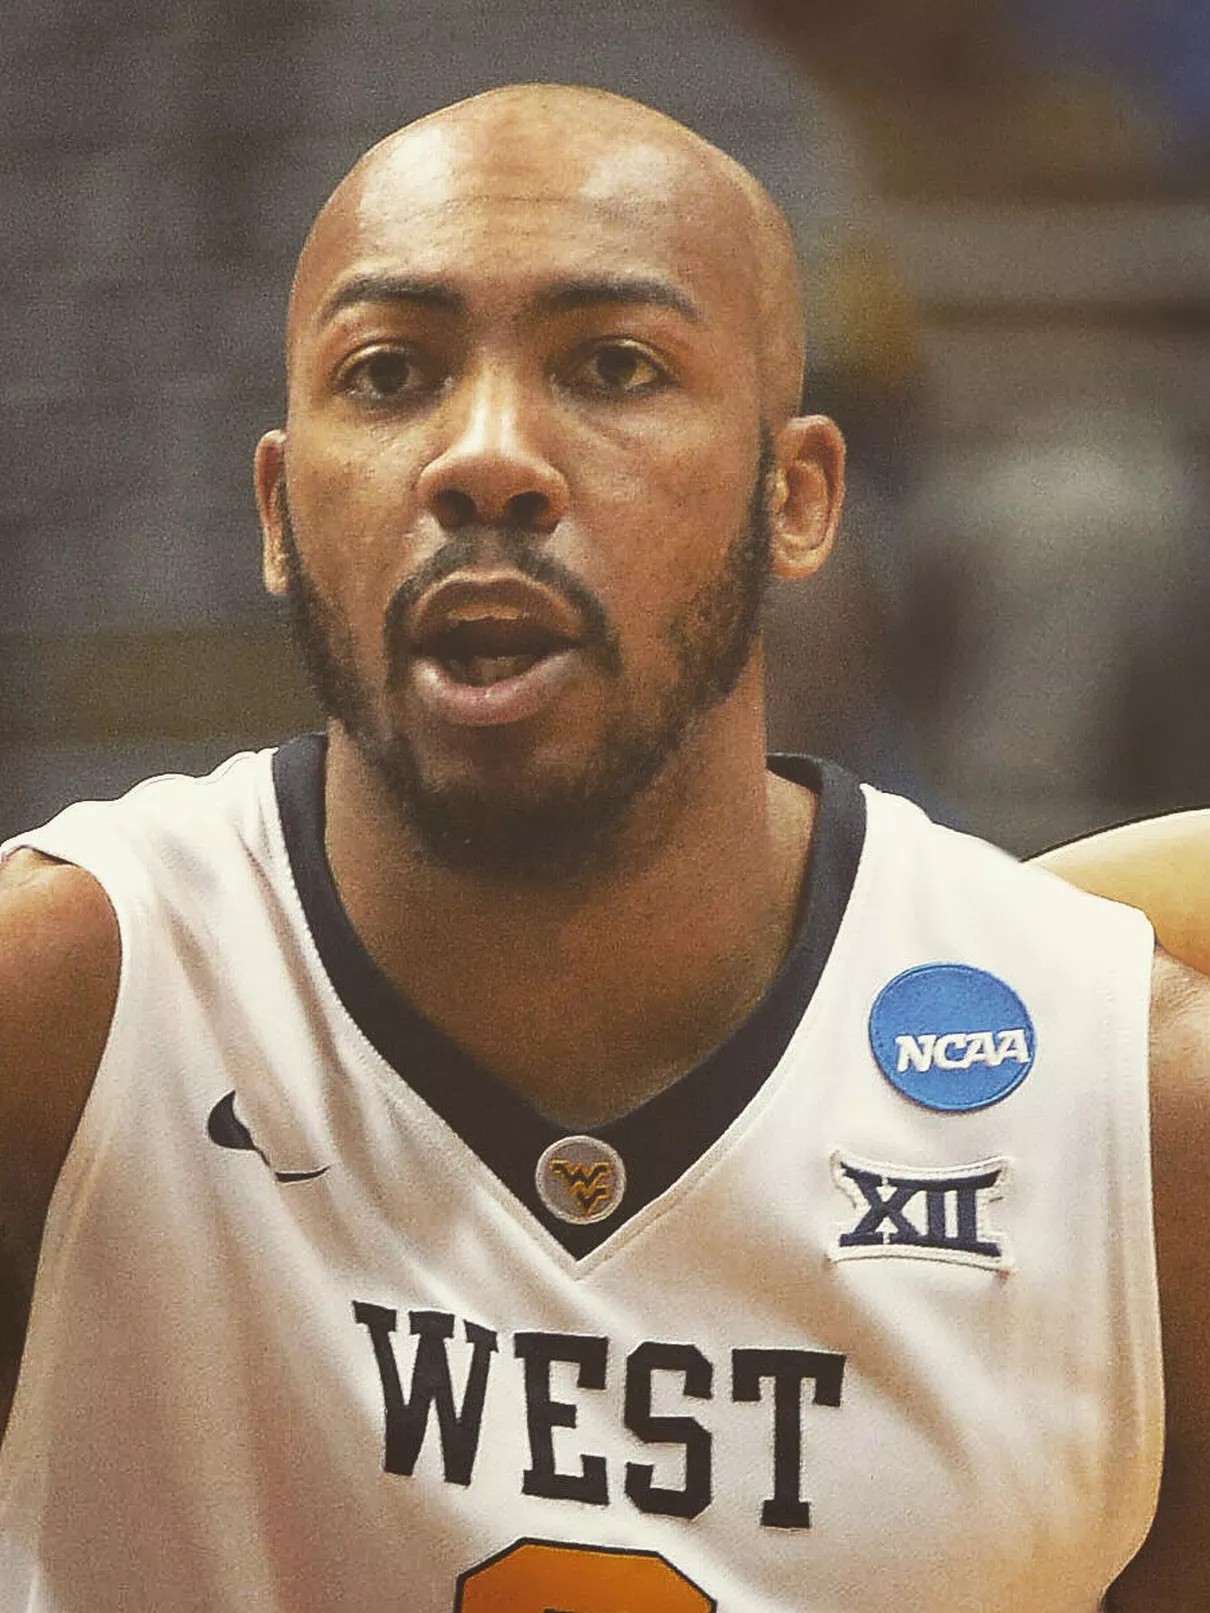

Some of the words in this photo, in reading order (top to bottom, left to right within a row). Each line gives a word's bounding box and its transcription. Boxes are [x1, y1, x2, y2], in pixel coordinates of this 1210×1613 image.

[895, 1028, 1031, 1073] NCAA
[839, 1160, 1003, 1257] XII
[352, 1300, 847, 1529] WEST
